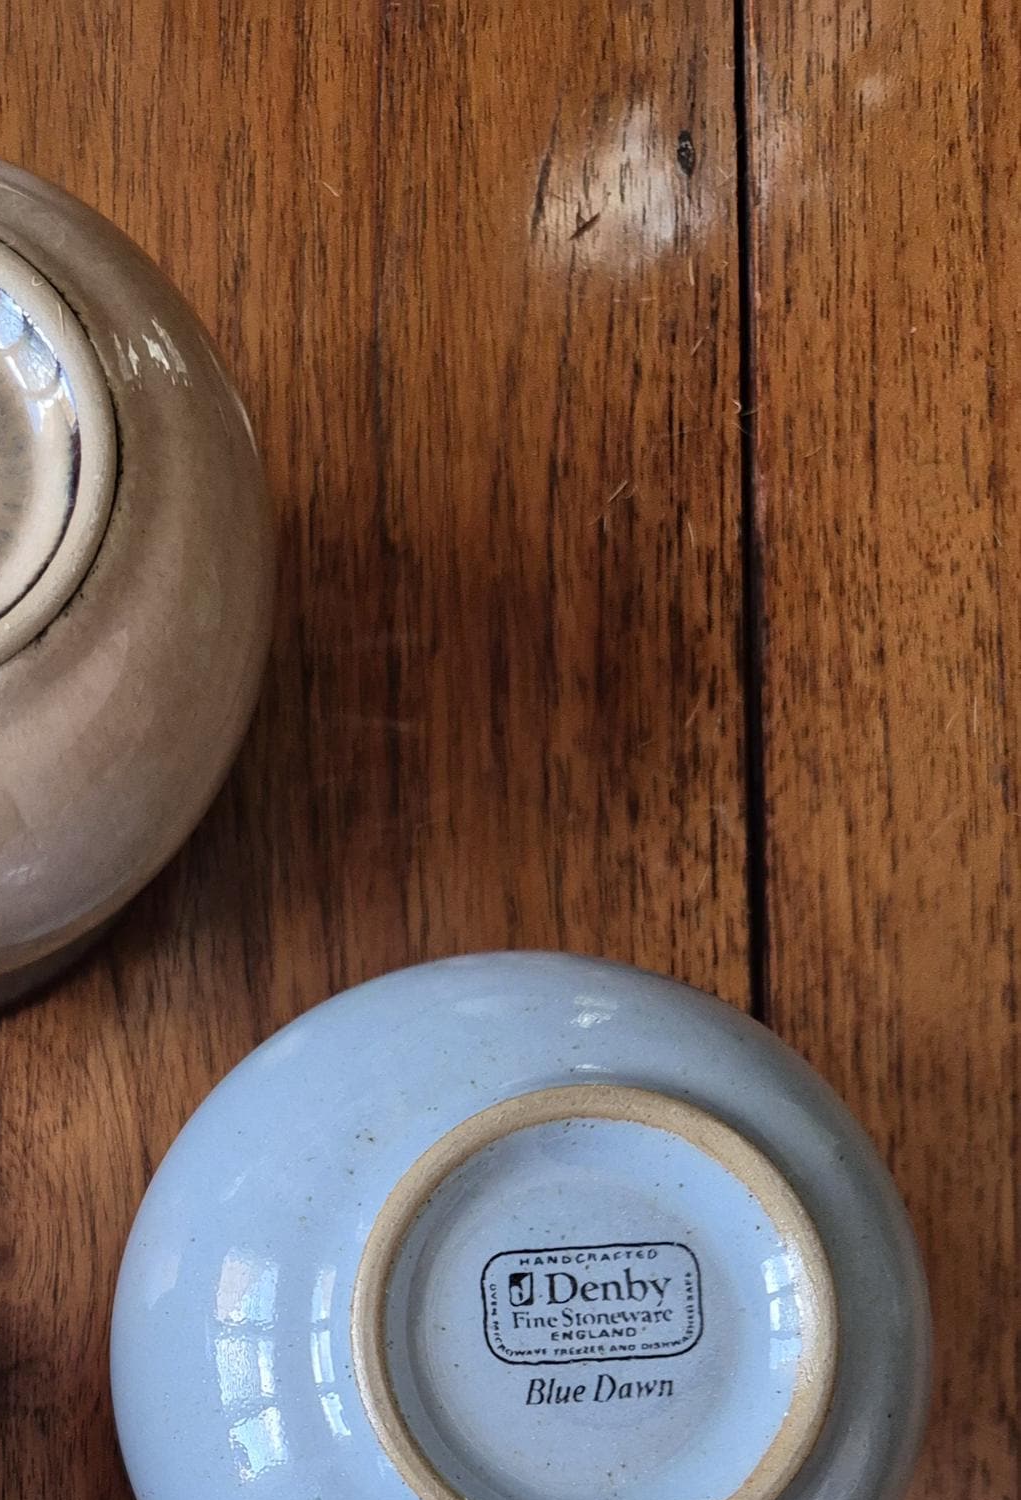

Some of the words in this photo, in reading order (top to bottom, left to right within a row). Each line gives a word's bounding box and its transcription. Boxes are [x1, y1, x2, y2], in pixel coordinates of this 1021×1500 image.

[519, 1249, 658, 1266] HANDCRAFTED
[544, 1267, 672, 1307] Denby
[512, 1311, 559, 1329] Fine
[561, 1307, 674, 1328] Stoneware
[551, 1327, 637, 1341] ENGLAND
[526, 1378, 587, 1405] Blue
[593, 1373, 674, 1402] Dawn
